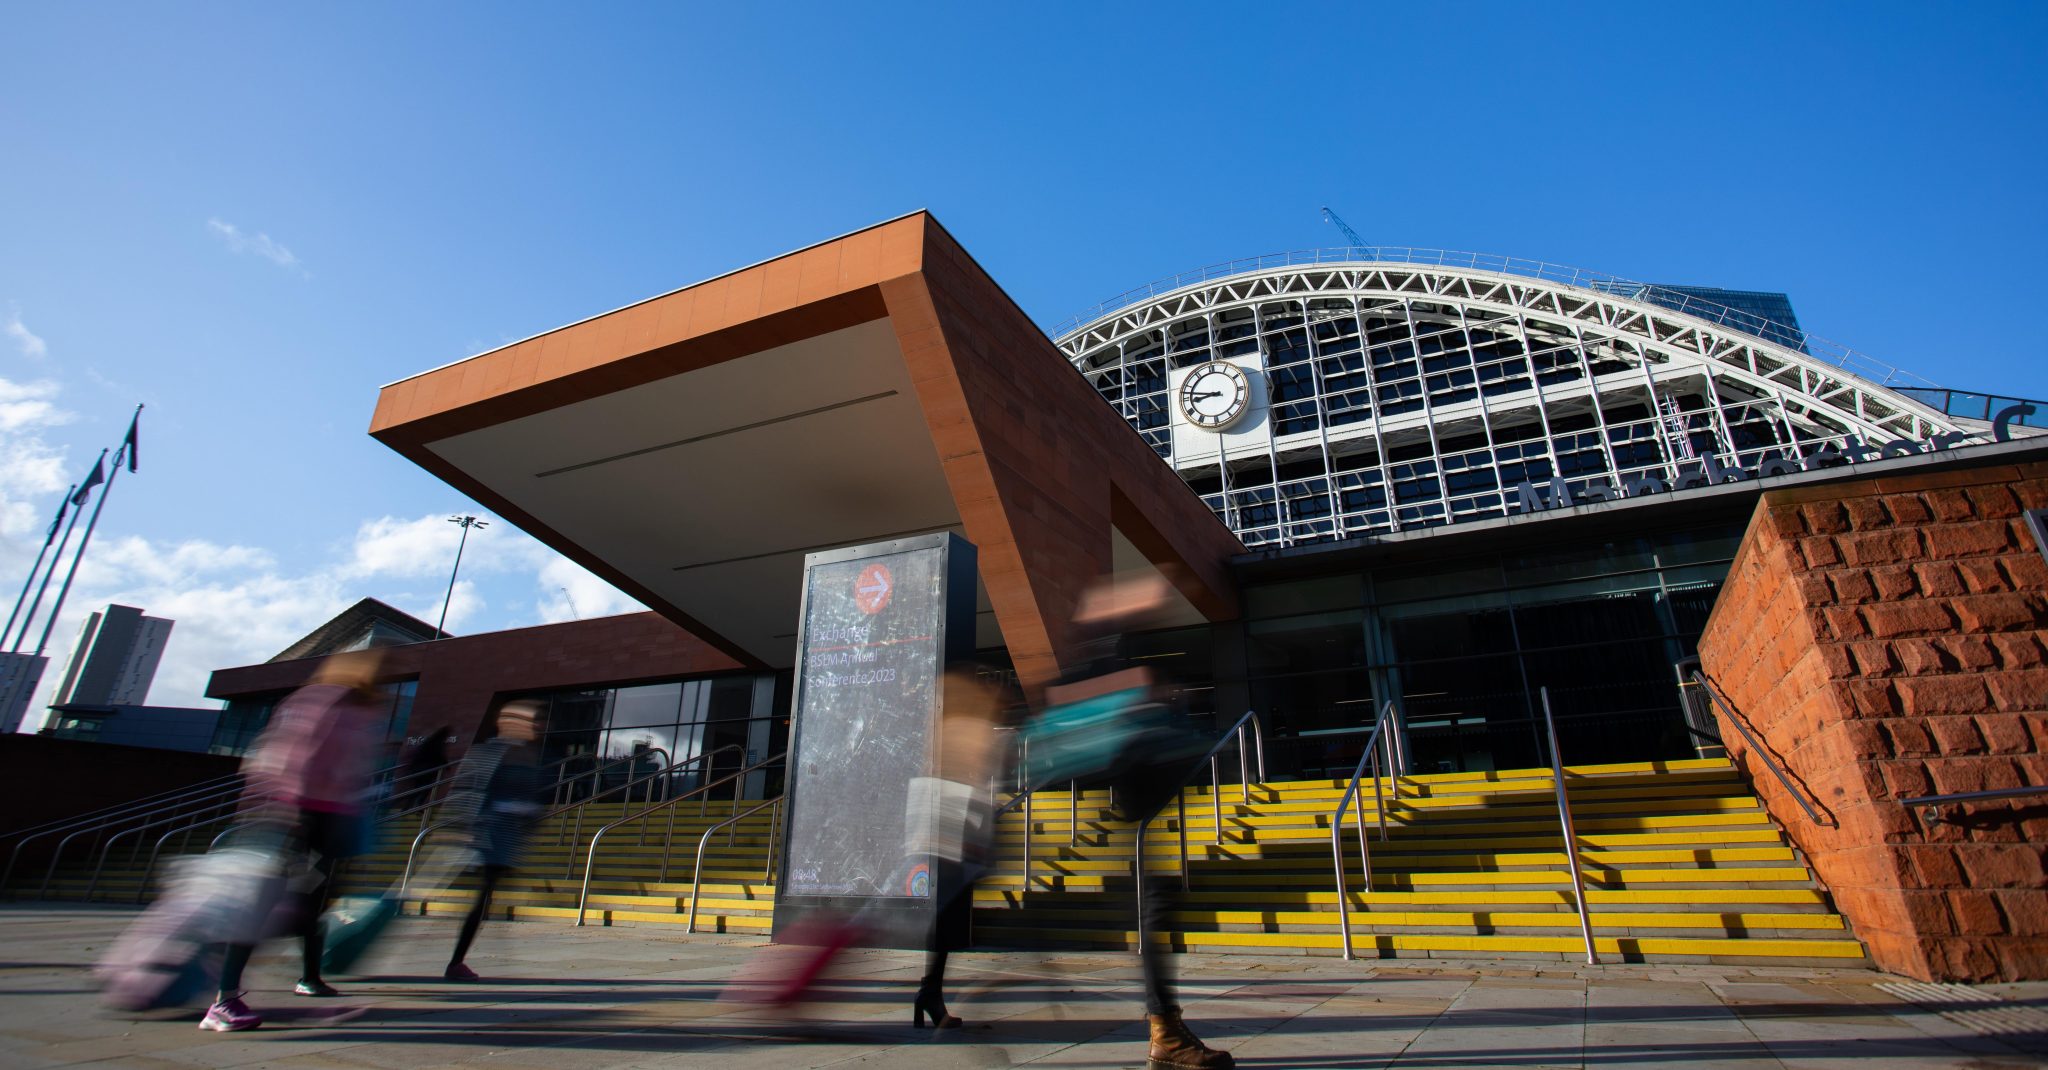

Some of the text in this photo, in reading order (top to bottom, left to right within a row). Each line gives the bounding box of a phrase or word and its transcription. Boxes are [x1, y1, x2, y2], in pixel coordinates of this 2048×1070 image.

[812, 624, 868, 642] Exchange
[840, 648, 878, 665] Annual
[869, 668, 896, 683] 2023
